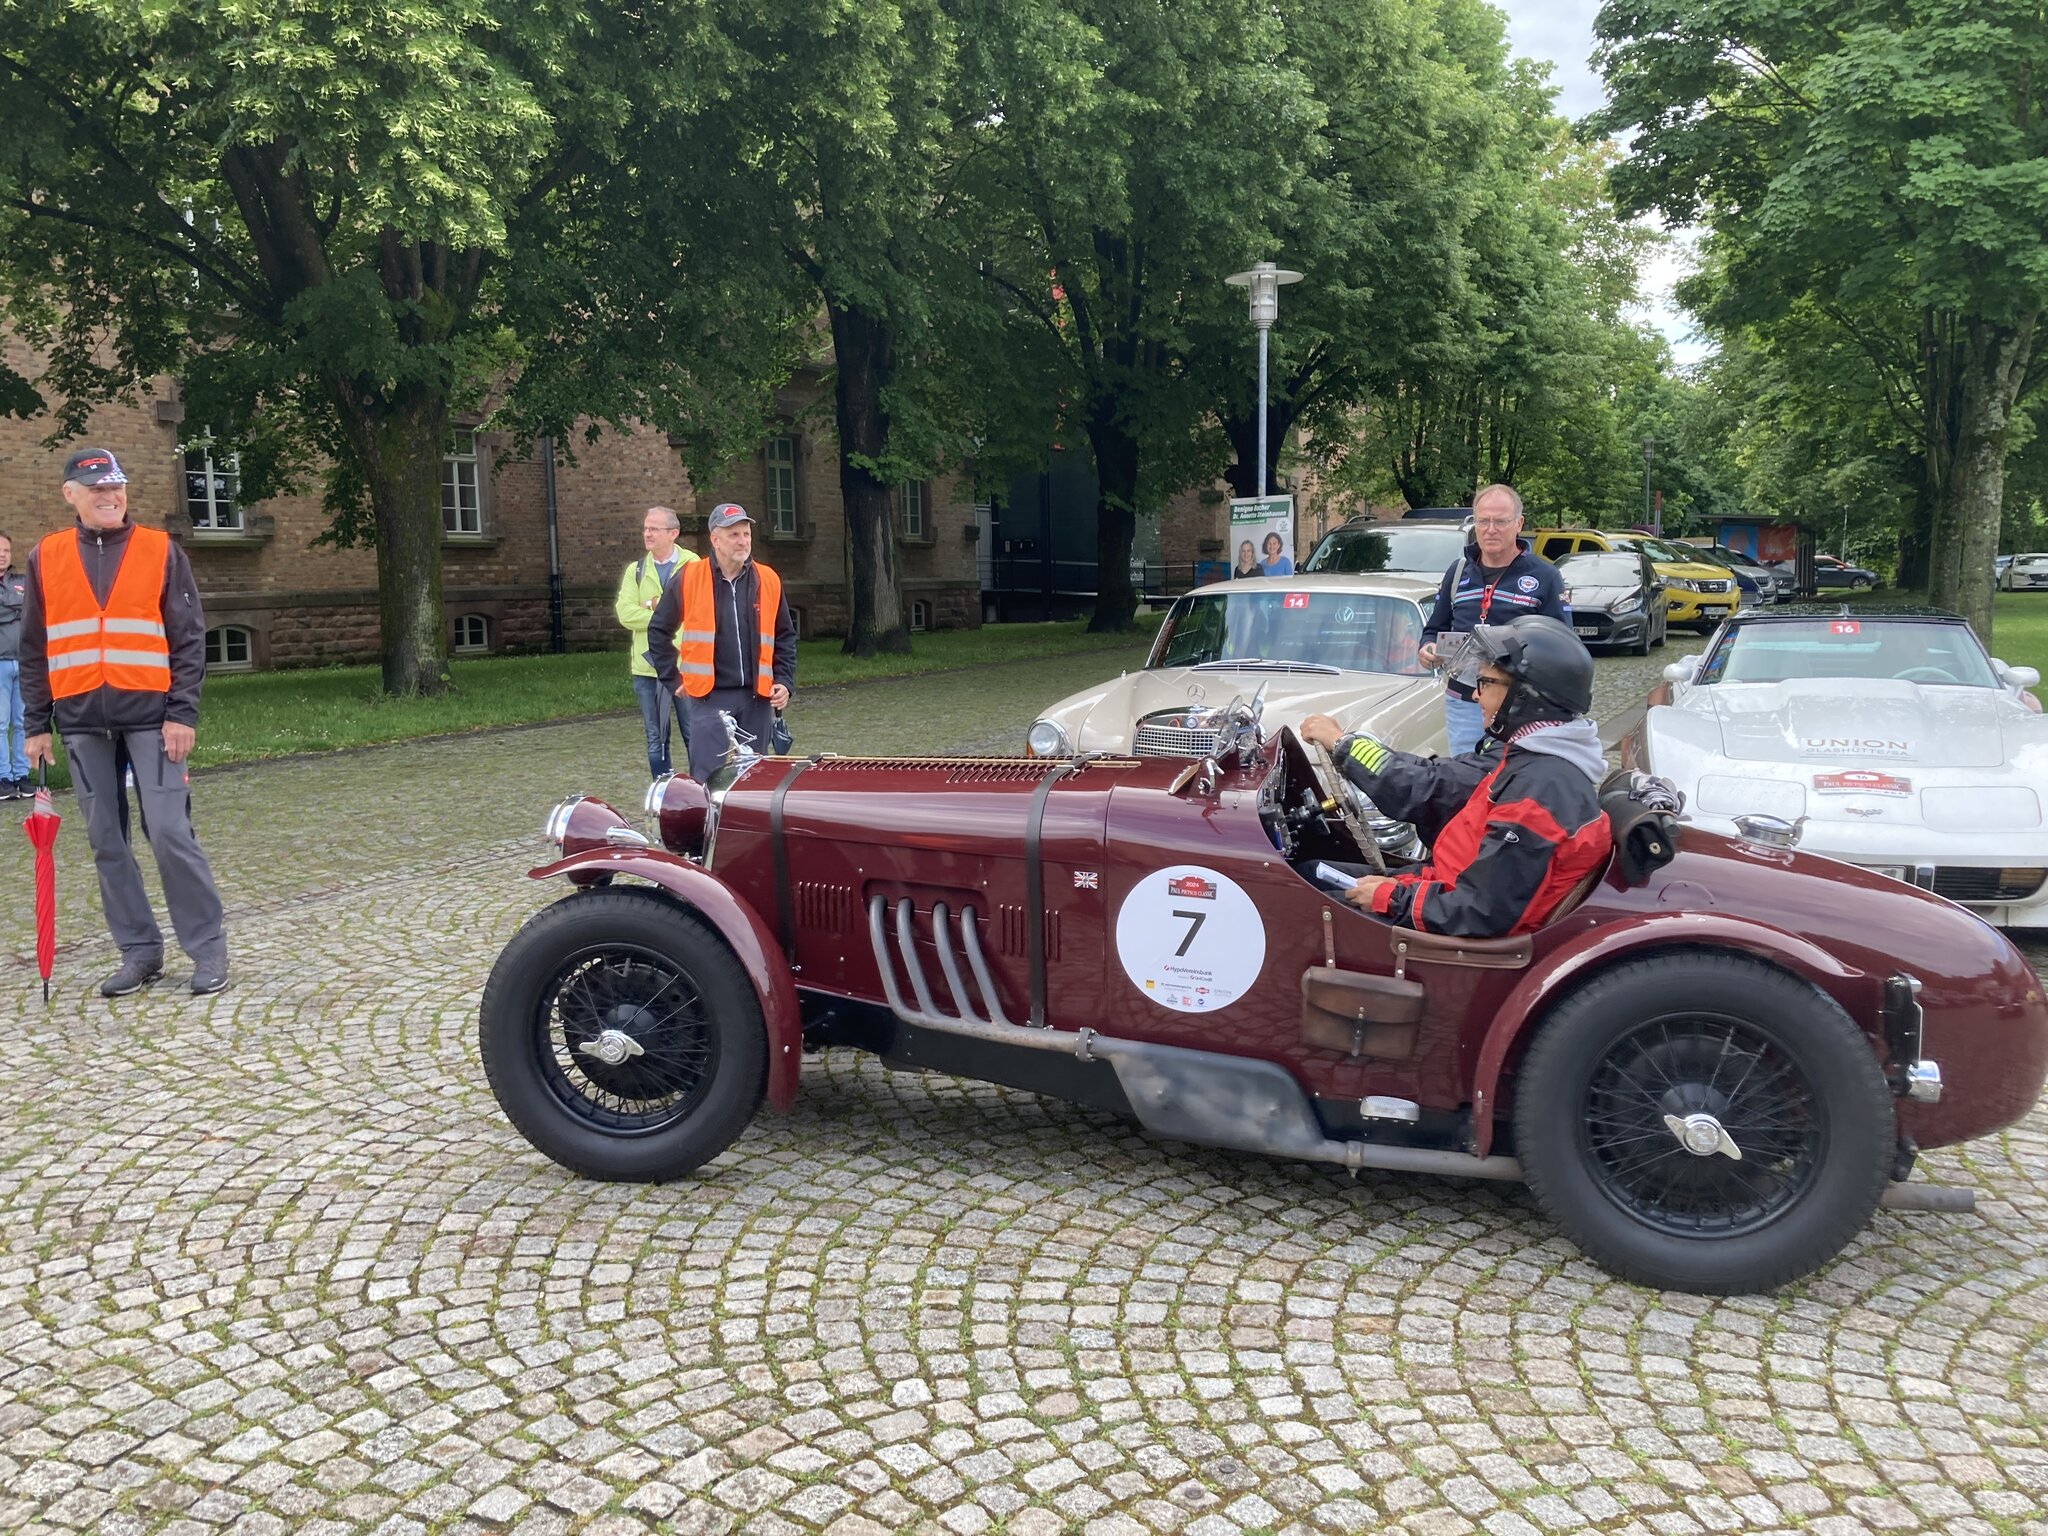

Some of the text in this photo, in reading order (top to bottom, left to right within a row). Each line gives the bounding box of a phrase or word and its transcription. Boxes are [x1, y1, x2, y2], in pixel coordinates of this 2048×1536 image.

[1289, 598, 1304, 608] 14
[1836, 625, 1854, 633] 16
[1807, 739, 1908, 750] UNION
[1173, 910, 1206, 957] 7
